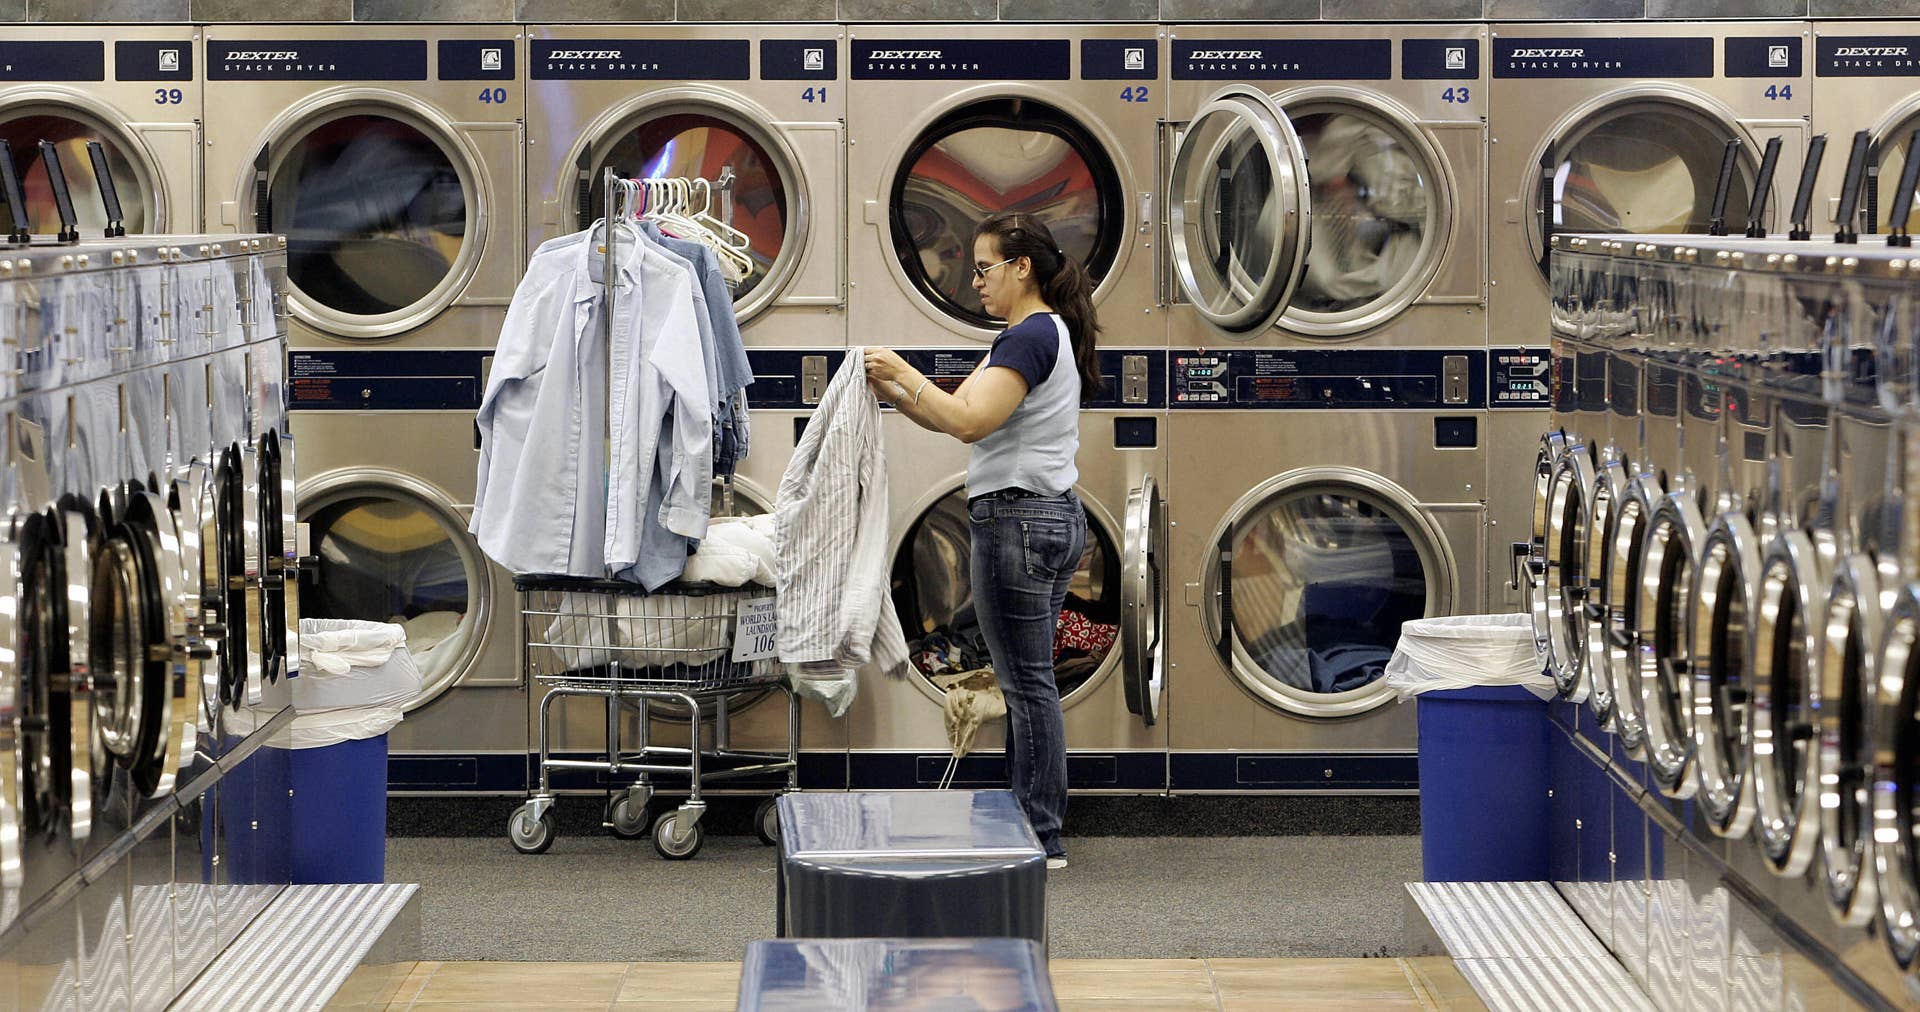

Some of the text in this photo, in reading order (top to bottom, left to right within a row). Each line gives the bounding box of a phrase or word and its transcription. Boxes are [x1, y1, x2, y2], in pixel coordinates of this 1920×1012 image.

[225, 51, 298, 60] DEXTER
[549, 51, 622, 60] DEXTER
[869, 50, 942, 59] DEXTER
[1189, 50, 1262, 59] DEXTER
[1511, 49, 1584, 58] DEXTER
[1834, 47, 1907, 56] DEXTER
[1510, 61, 1622, 69] STACK DRYER
[155, 88, 182, 104] 39
[478, 87, 507, 103] 40
[801, 87, 827, 103] 41
[1120, 86, 1149, 102] 42
[1441, 87, 1470, 103] 43
[1764, 84, 1792, 100] 44
[740, 613, 767, 625] WORLD'S
[753, 633, 776, 653] 106
